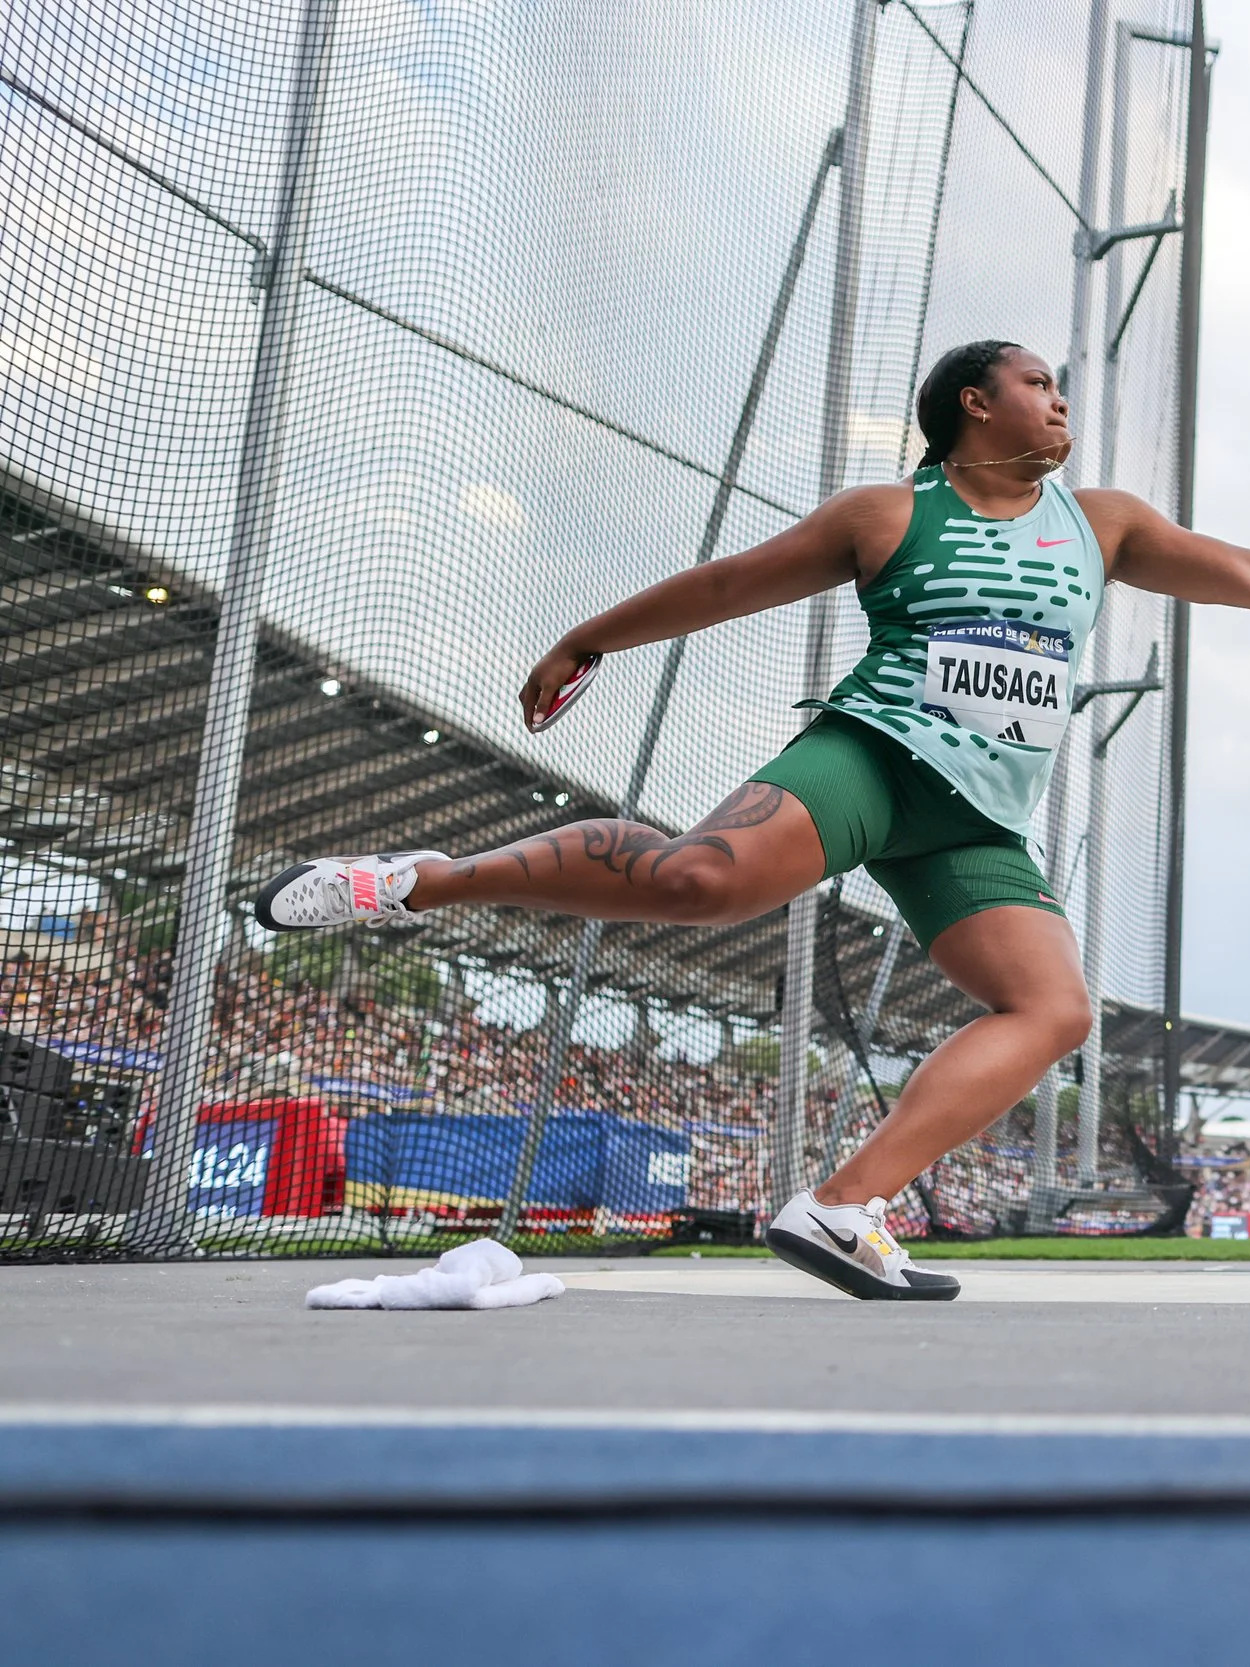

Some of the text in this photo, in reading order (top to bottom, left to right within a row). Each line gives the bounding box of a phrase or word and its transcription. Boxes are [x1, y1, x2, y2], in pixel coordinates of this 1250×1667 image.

[934, 626, 1064, 654] MEETING DE PARIS
[939, 656, 1058, 709] TAUSAGA
[352, 868, 378, 912] NIKE
